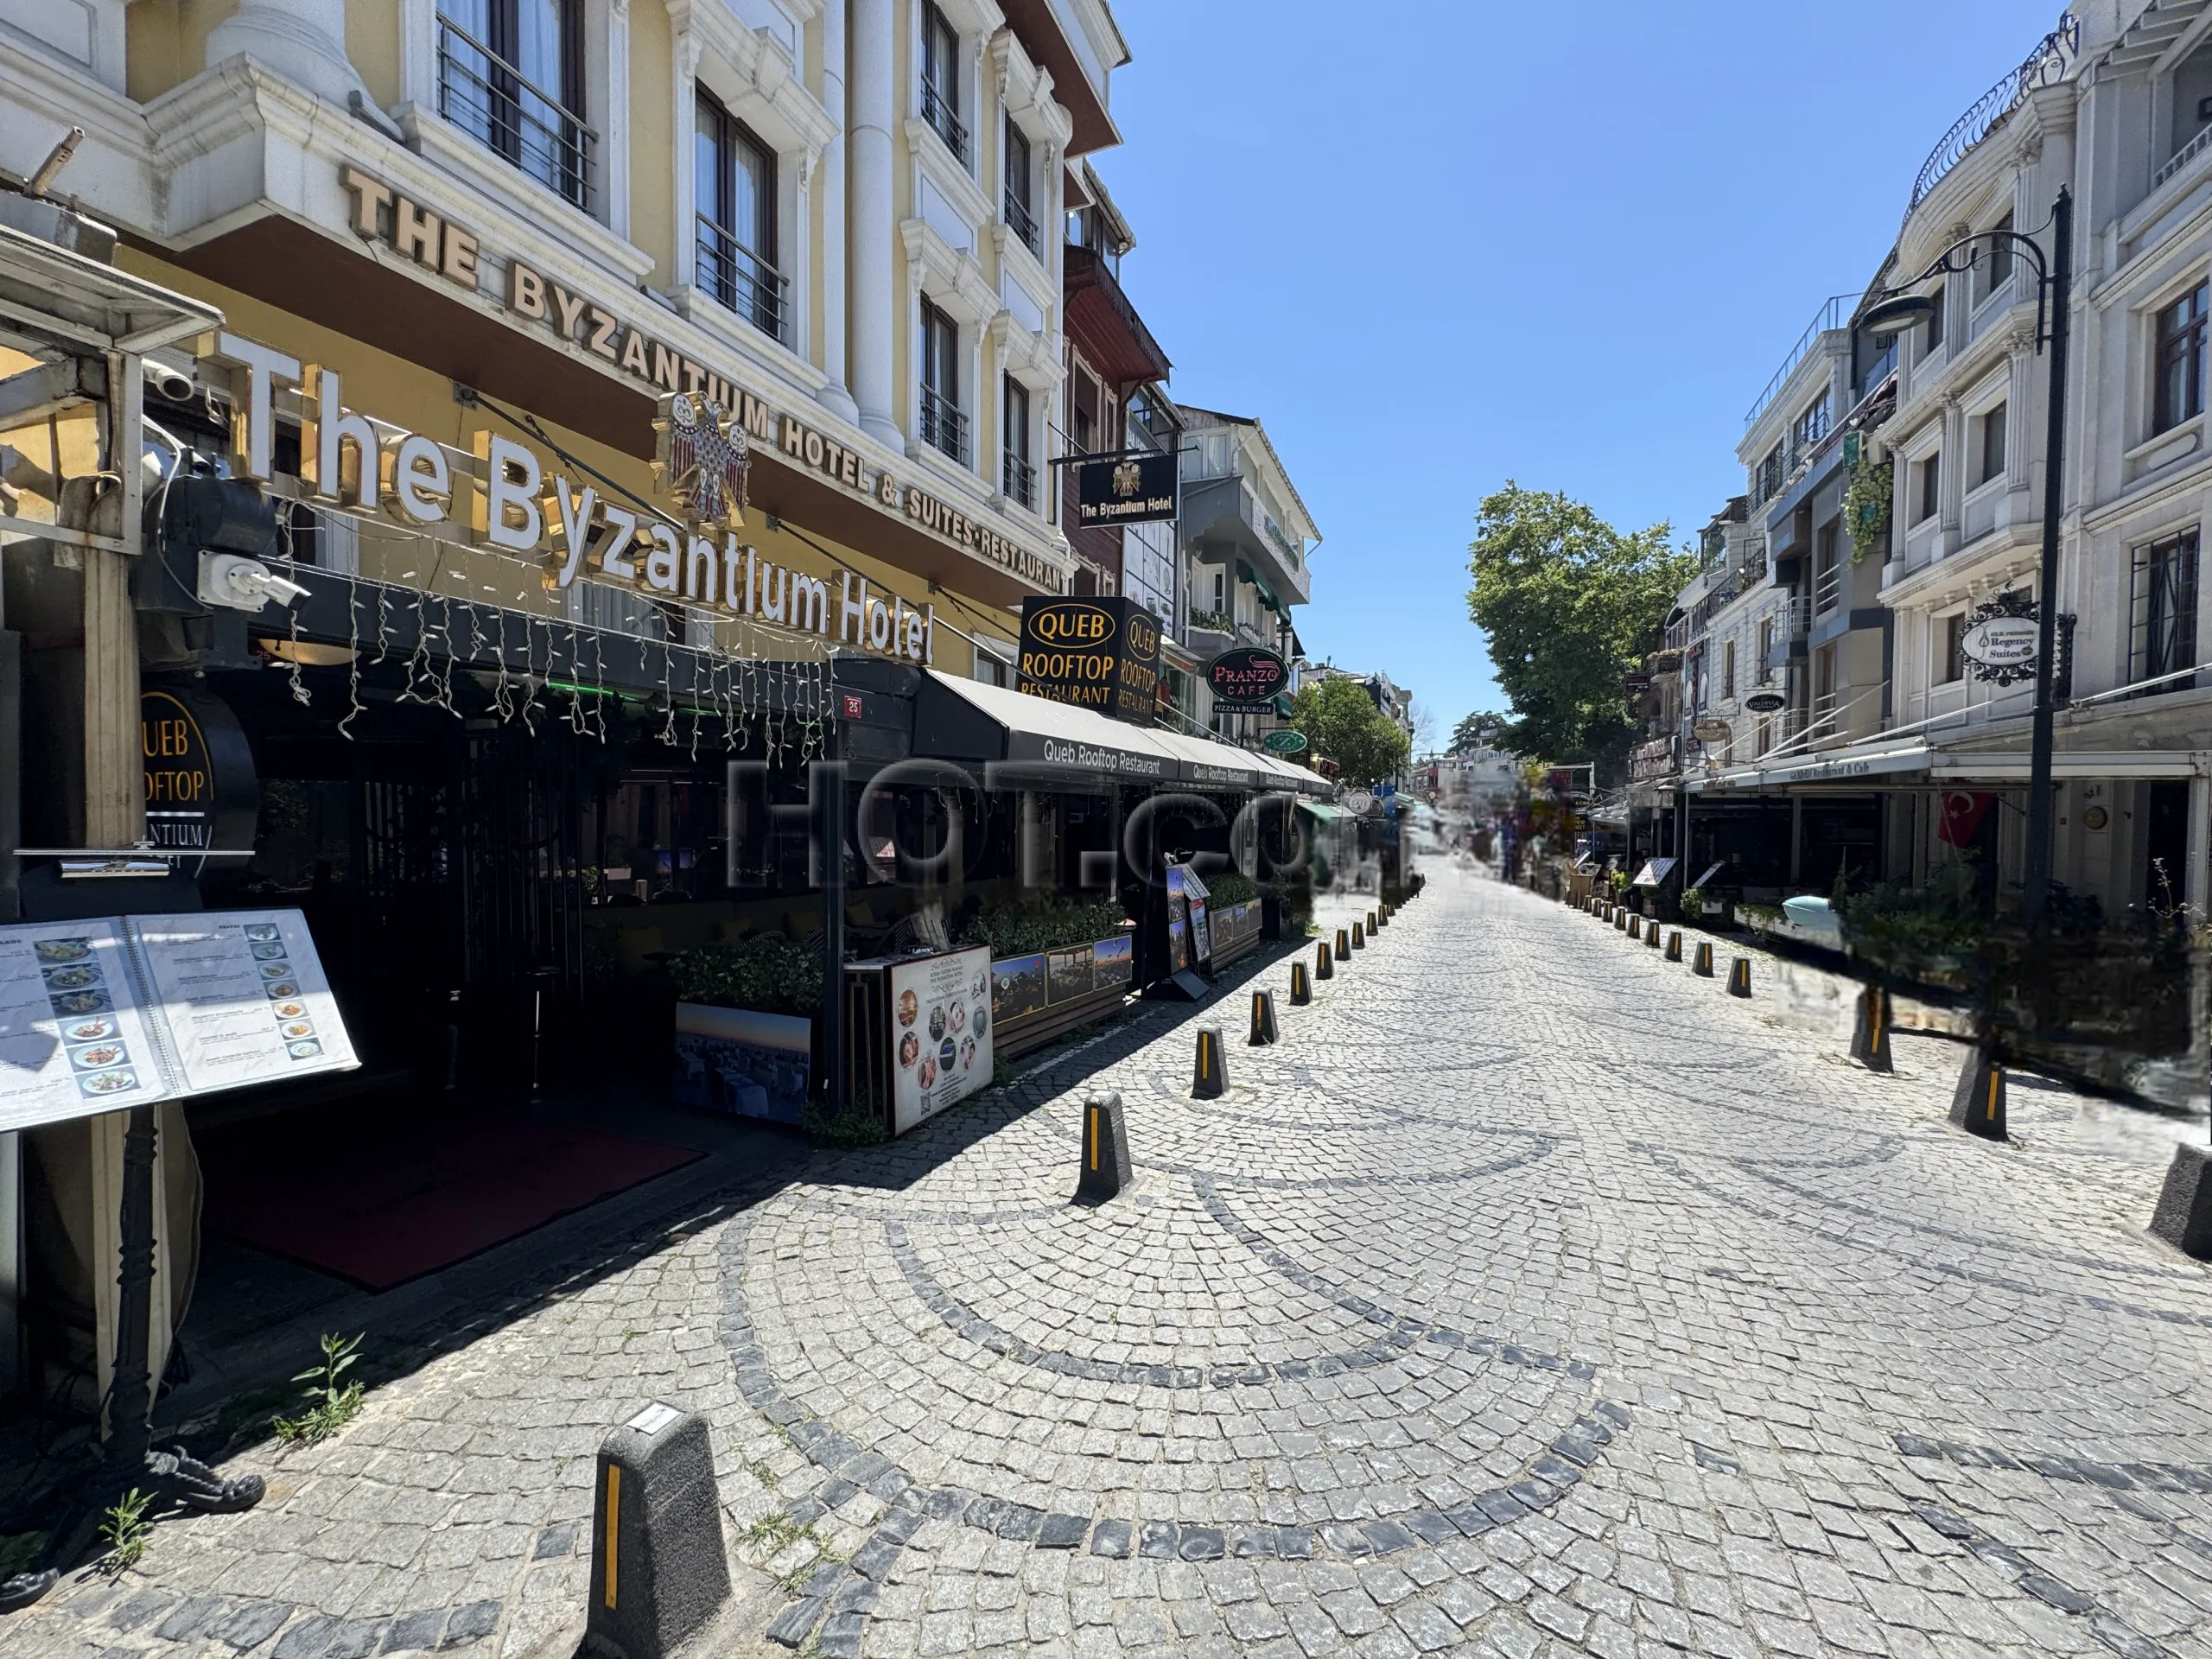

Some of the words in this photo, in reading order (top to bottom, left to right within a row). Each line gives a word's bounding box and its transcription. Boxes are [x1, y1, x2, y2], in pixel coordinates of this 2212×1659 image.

[343, 165, 480, 292] THE
[508, 260, 769, 438] BYZANTIUM
[781, 416, 870, 493] HOTEL
[878, 474, 897, 507] &
[209, 329, 452, 525] The
[836, 569, 935, 666] Hotel
[1080, 504, 1096, 518] The
[1147, 495, 1173, 512] Hotel
[1039, 613, 1104, 639] QUEB
[1129, 620, 1155, 653] QUEB
[1989, 649, 2021, 658] Suites
[1990, 638, 2035, 648] Regency
[1022, 652, 1114, 680] ROOFTOP
[1120, 658, 1156, 692] ROOFTOP
[1213, 666, 1279, 683] PRANZO
[1020, 682, 1111, 704] RESTAURANT
[1227, 685, 1265, 696] CAFE
[849, 701, 859, 713] 25
[142, 719, 188, 757] UEB
[1044, 739, 1076, 764] Queb
[1078, 745, 1117, 772] Rooftop
[1119, 752, 1160, 775] Restaurant
[1193, 764, 1208, 779] Queb
[1208, 766, 1227, 783] Rooftop
[1227, 768, 1249, 783] Restaurant
[144, 770, 205, 802] OFTOP
[149, 824, 203, 846] NTIUM
